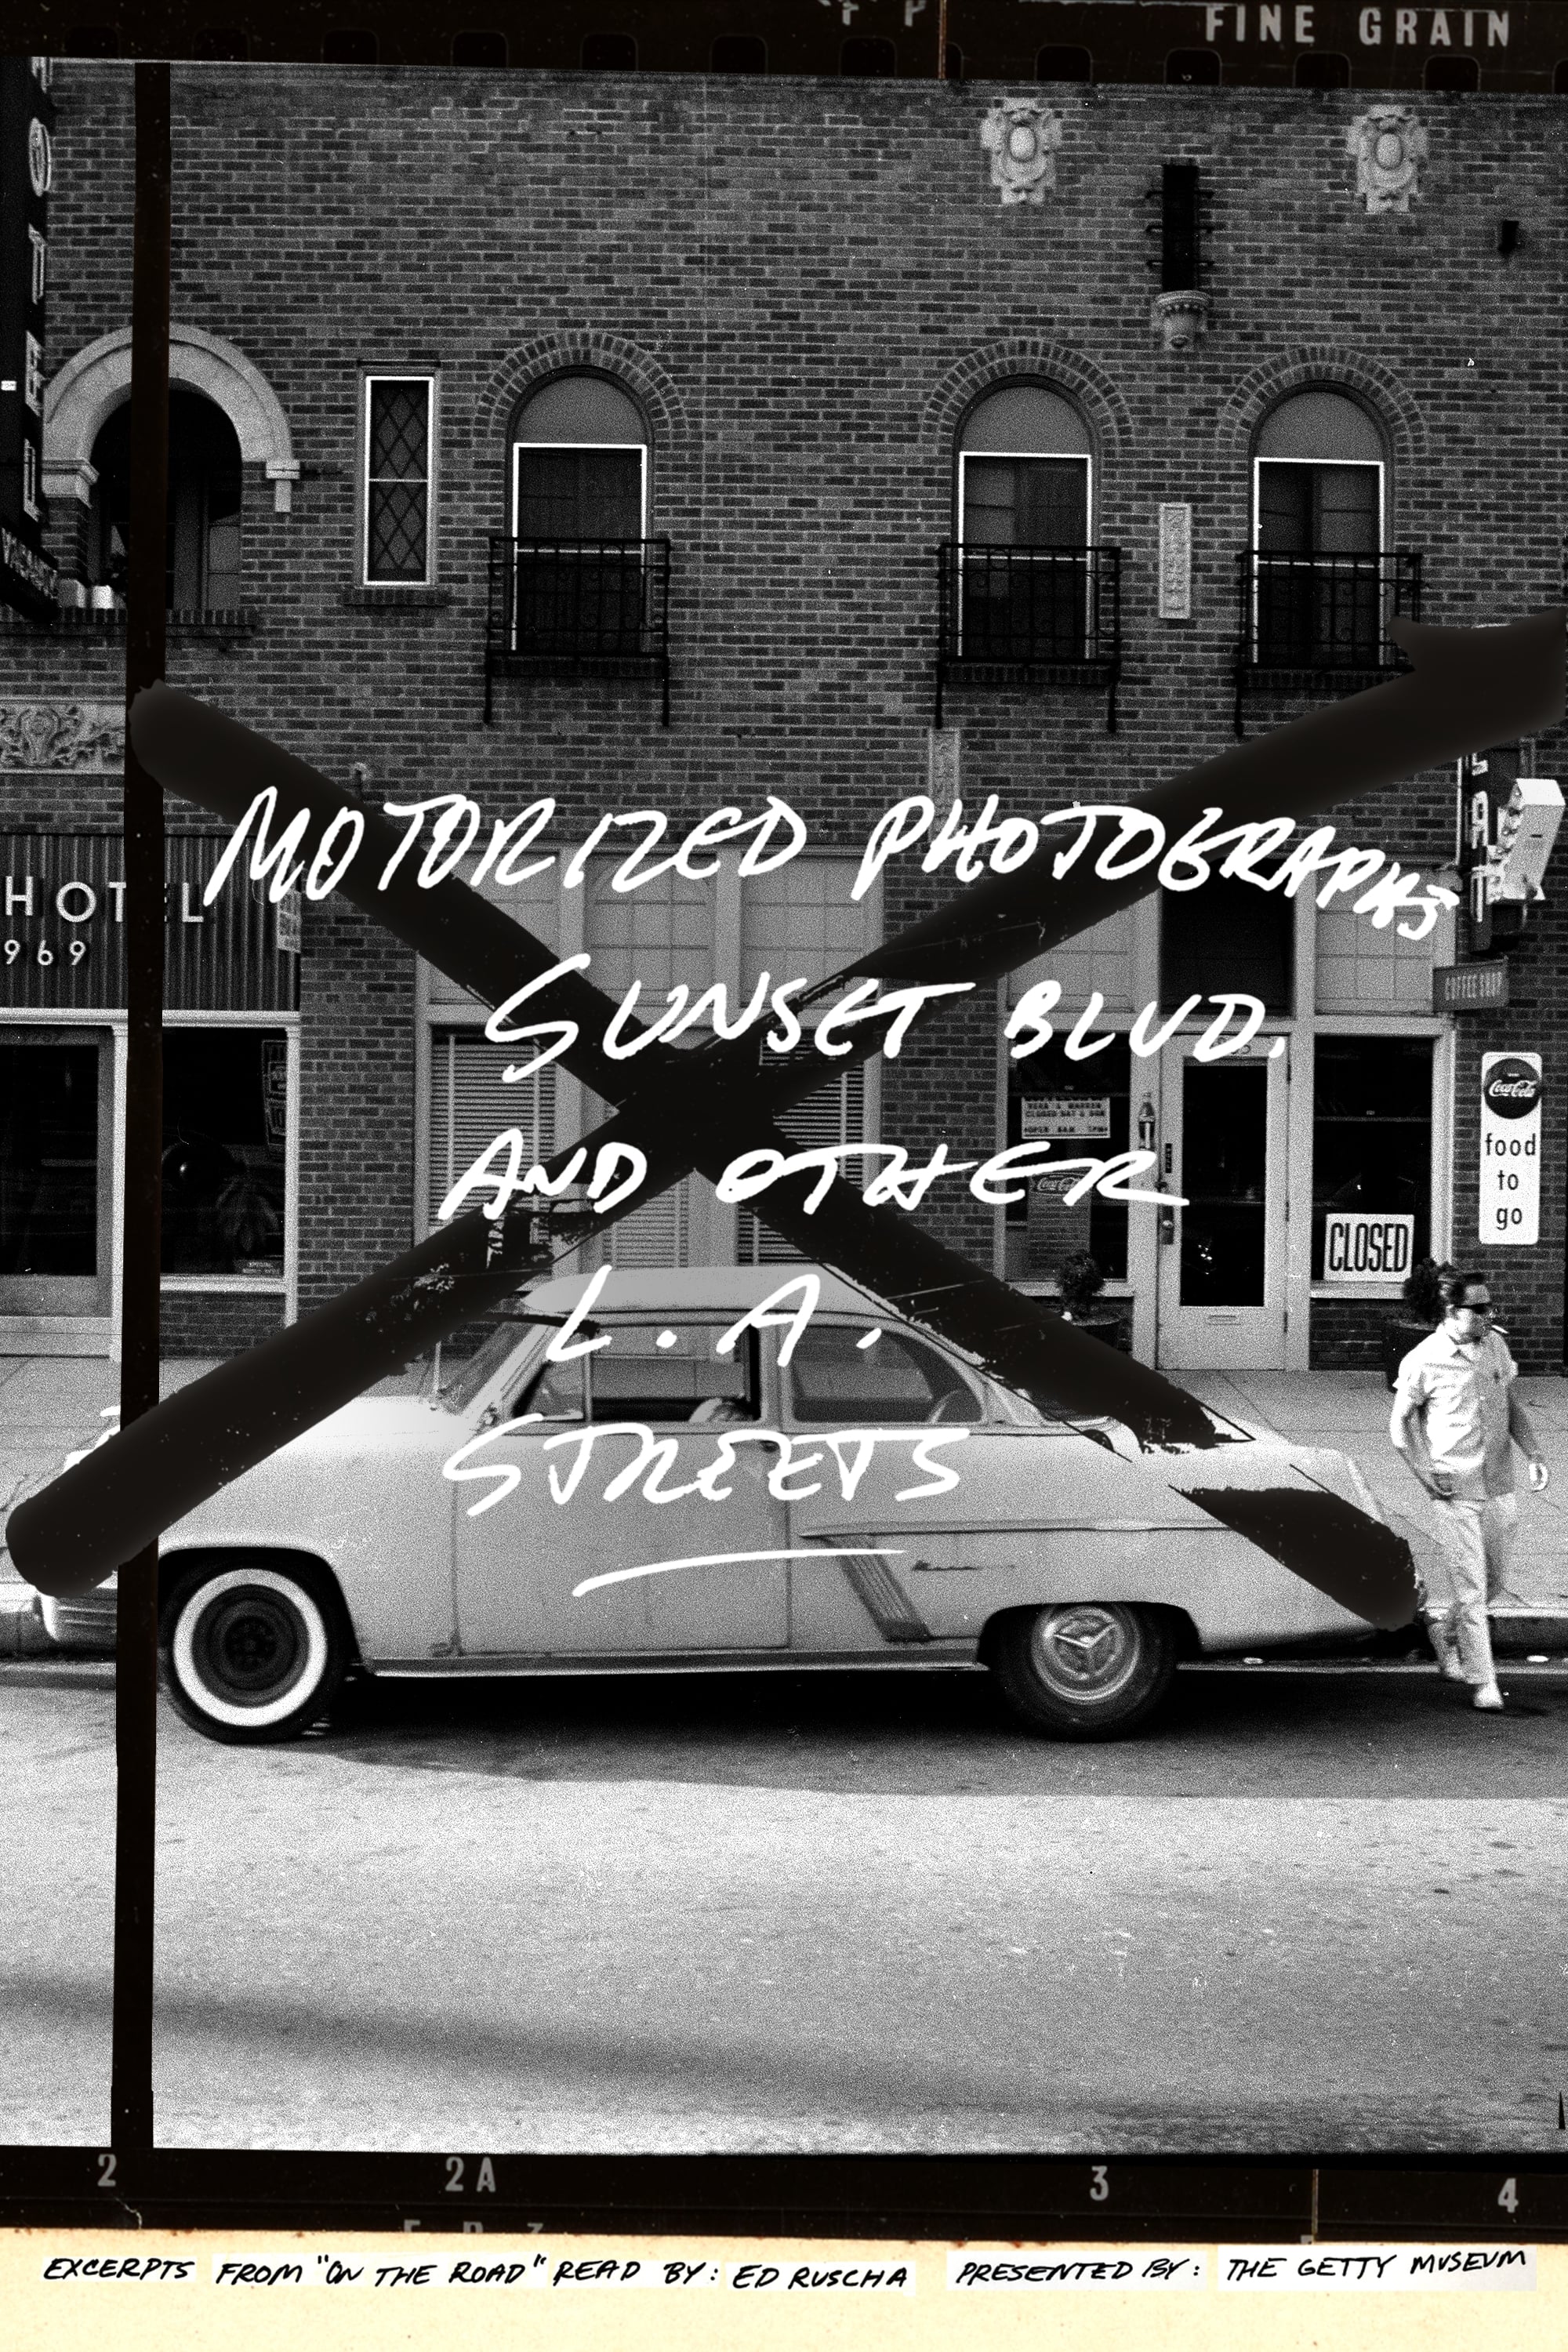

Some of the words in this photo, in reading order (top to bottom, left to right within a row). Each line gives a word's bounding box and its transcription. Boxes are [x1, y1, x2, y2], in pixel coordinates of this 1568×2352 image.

[1205, 5, 1315, 42] FINE
[1359, 7, 1509, 47] GRAIN
[5, 875, 205, 924] HOTL
[1489, 1080, 1537, 1098] Coca-Cola
[1485, 1133, 1536, 1156] food
[1498, 1170, 1519, 1191] to
[1496, 1207, 1523, 1231] go
[1329, 1222, 1409, 1272] CLOSED
[97, 2154, 117, 2187] 2
[1091, 2165, 1109, 2201] 3
[1497, 2178, 1519, 2213] 4
